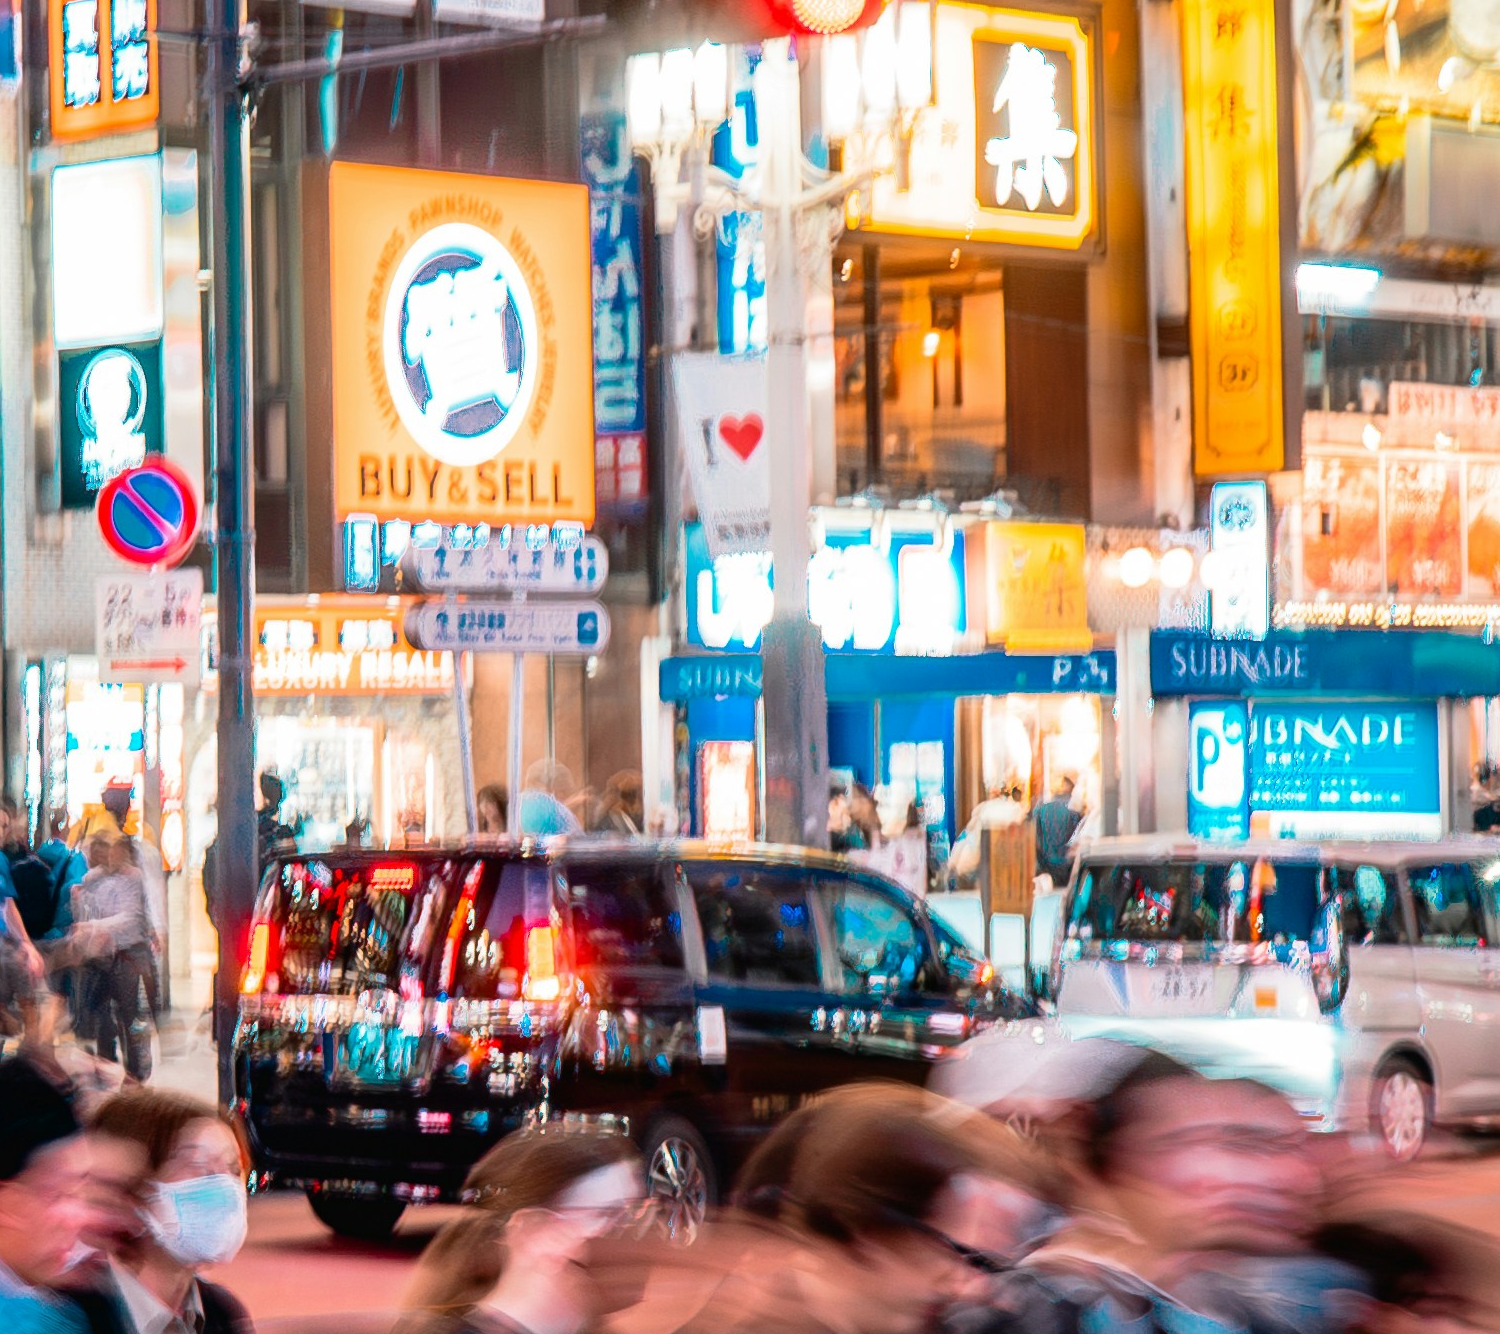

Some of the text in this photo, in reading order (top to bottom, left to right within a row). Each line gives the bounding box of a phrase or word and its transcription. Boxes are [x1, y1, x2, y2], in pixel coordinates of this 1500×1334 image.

[408, 194, 504, 232] PAWNSHOP
[359, 454, 574, 509] BUY & SELL
[253, 651, 350, 689] LUXURY
[1170, 641, 1309, 683] SUBNADE
